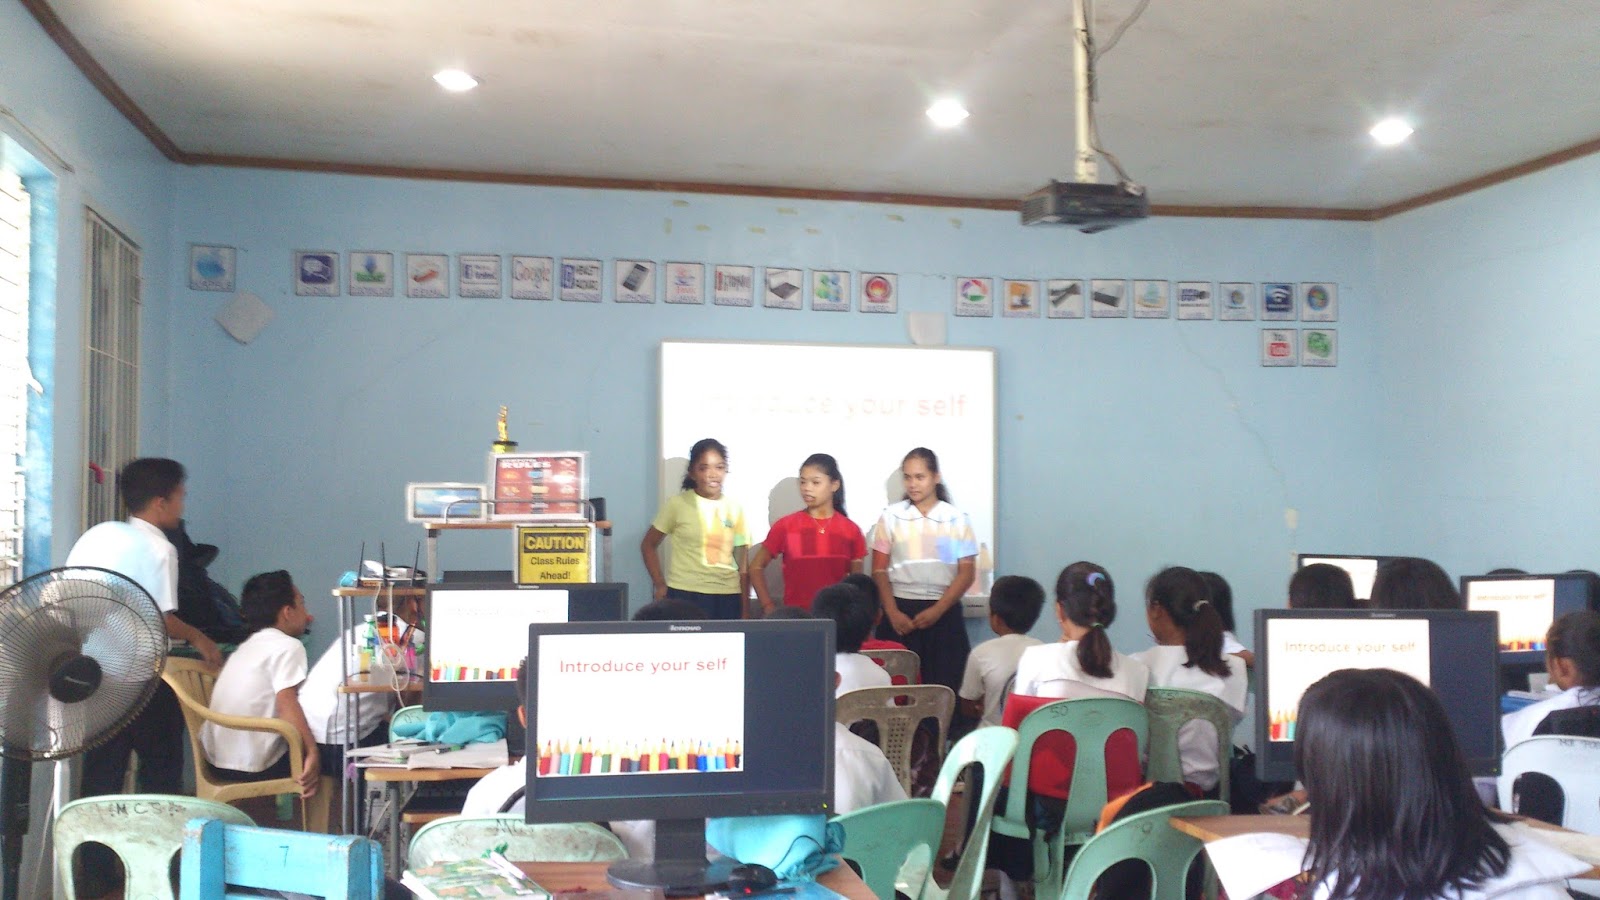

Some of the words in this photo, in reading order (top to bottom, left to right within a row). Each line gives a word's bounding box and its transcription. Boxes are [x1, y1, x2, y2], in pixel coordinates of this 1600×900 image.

[916, 394, 968, 416] self
[526, 536, 584, 549] CAUTION
[531, 557, 554, 565] Class
[556, 557, 580, 565] Rules
[540, 571, 571, 580] Ahead!
[1284, 641, 1350, 653] Introduce
[1356, 643, 1386, 655] your
[1391, 642, 1416, 653] self
[560, 659, 645, 674] Introduce
[651, 661, 691, 675] your
[696, 657, 728, 671] self
[279, 845, 290, 868] 7
